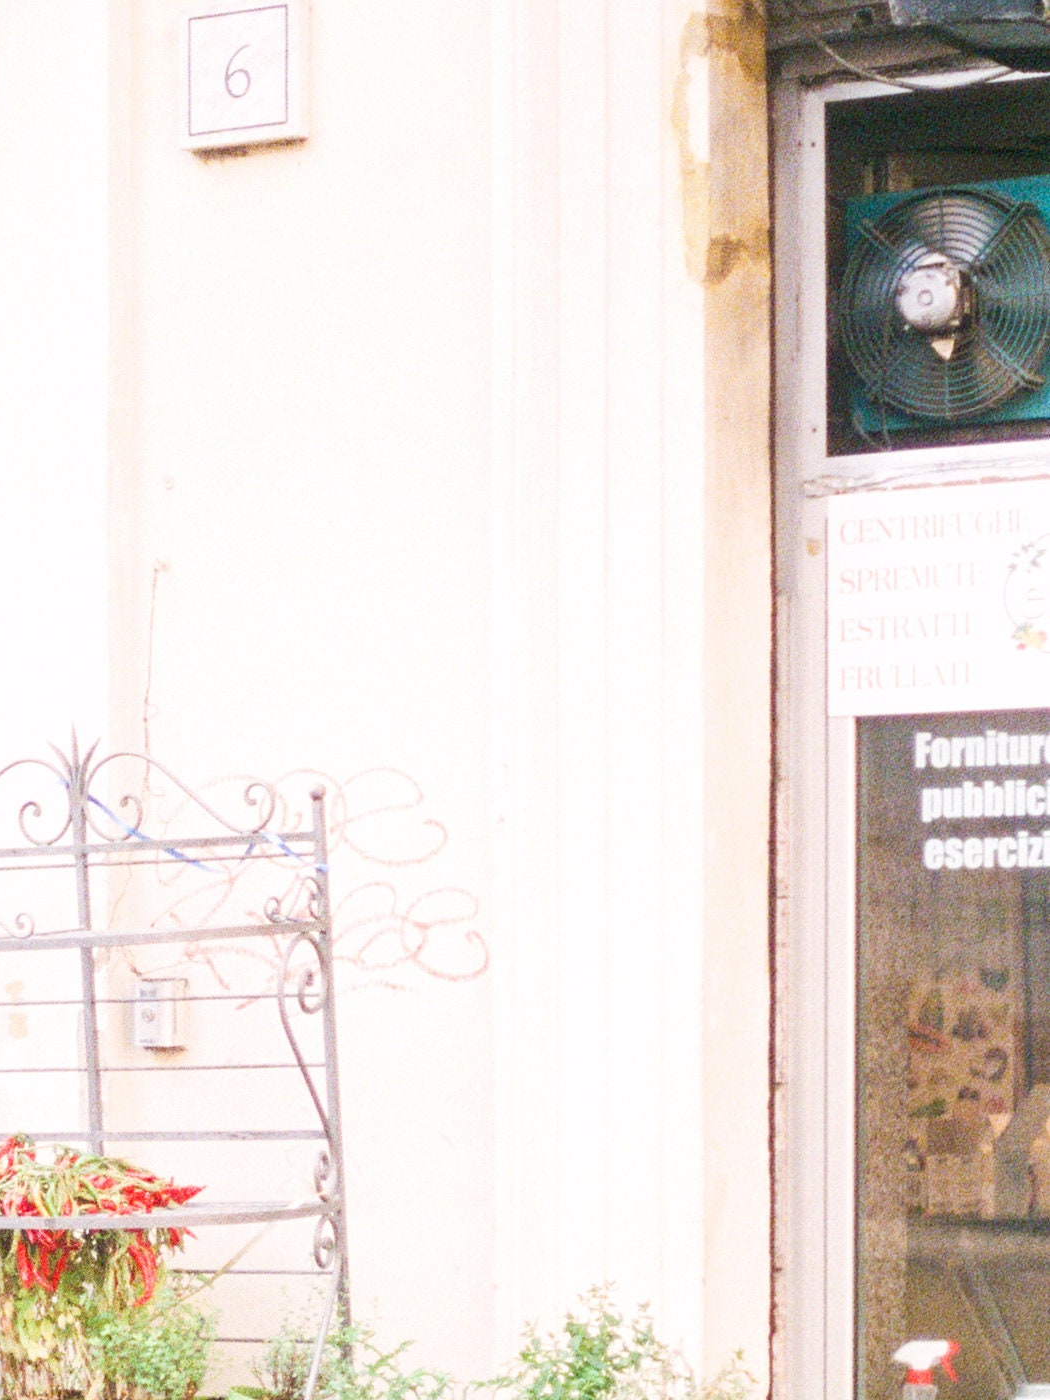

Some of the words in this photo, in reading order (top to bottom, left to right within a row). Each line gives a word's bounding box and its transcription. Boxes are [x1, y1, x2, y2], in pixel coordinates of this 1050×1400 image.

[224, 43, 251, 98] 6
[840, 508, 1030, 546] CENTRIFUGHE
[839, 562, 984, 595] SPREMUTE
[840, 611, 972, 643] ESTRATTI
[840, 661, 972, 692] FRULLATI
